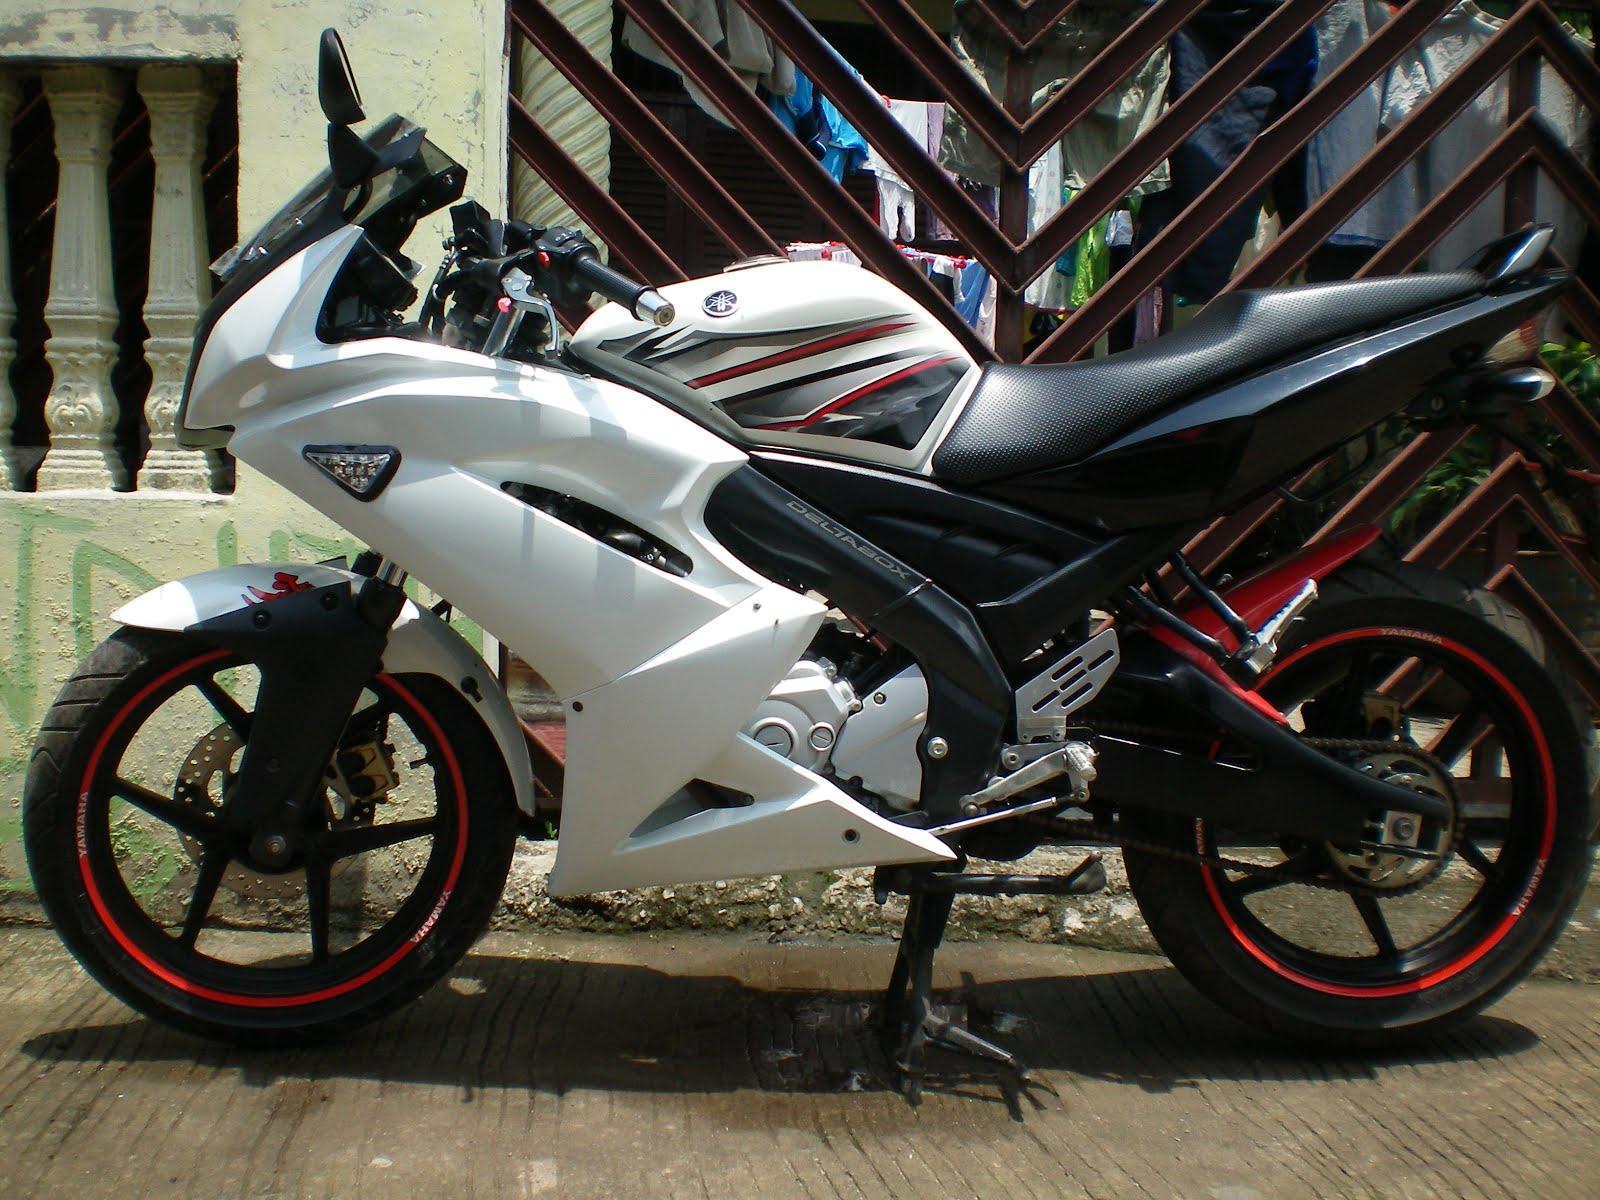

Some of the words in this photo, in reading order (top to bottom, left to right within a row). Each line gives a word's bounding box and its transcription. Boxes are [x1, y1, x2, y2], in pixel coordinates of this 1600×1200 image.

[786, 500, 912, 580] DELTABOX
[1379, 628, 1443, 645] YAMAHA
[76, 791, 89, 859] YAMAHA
[410, 890, 452, 943] YAMAHA
